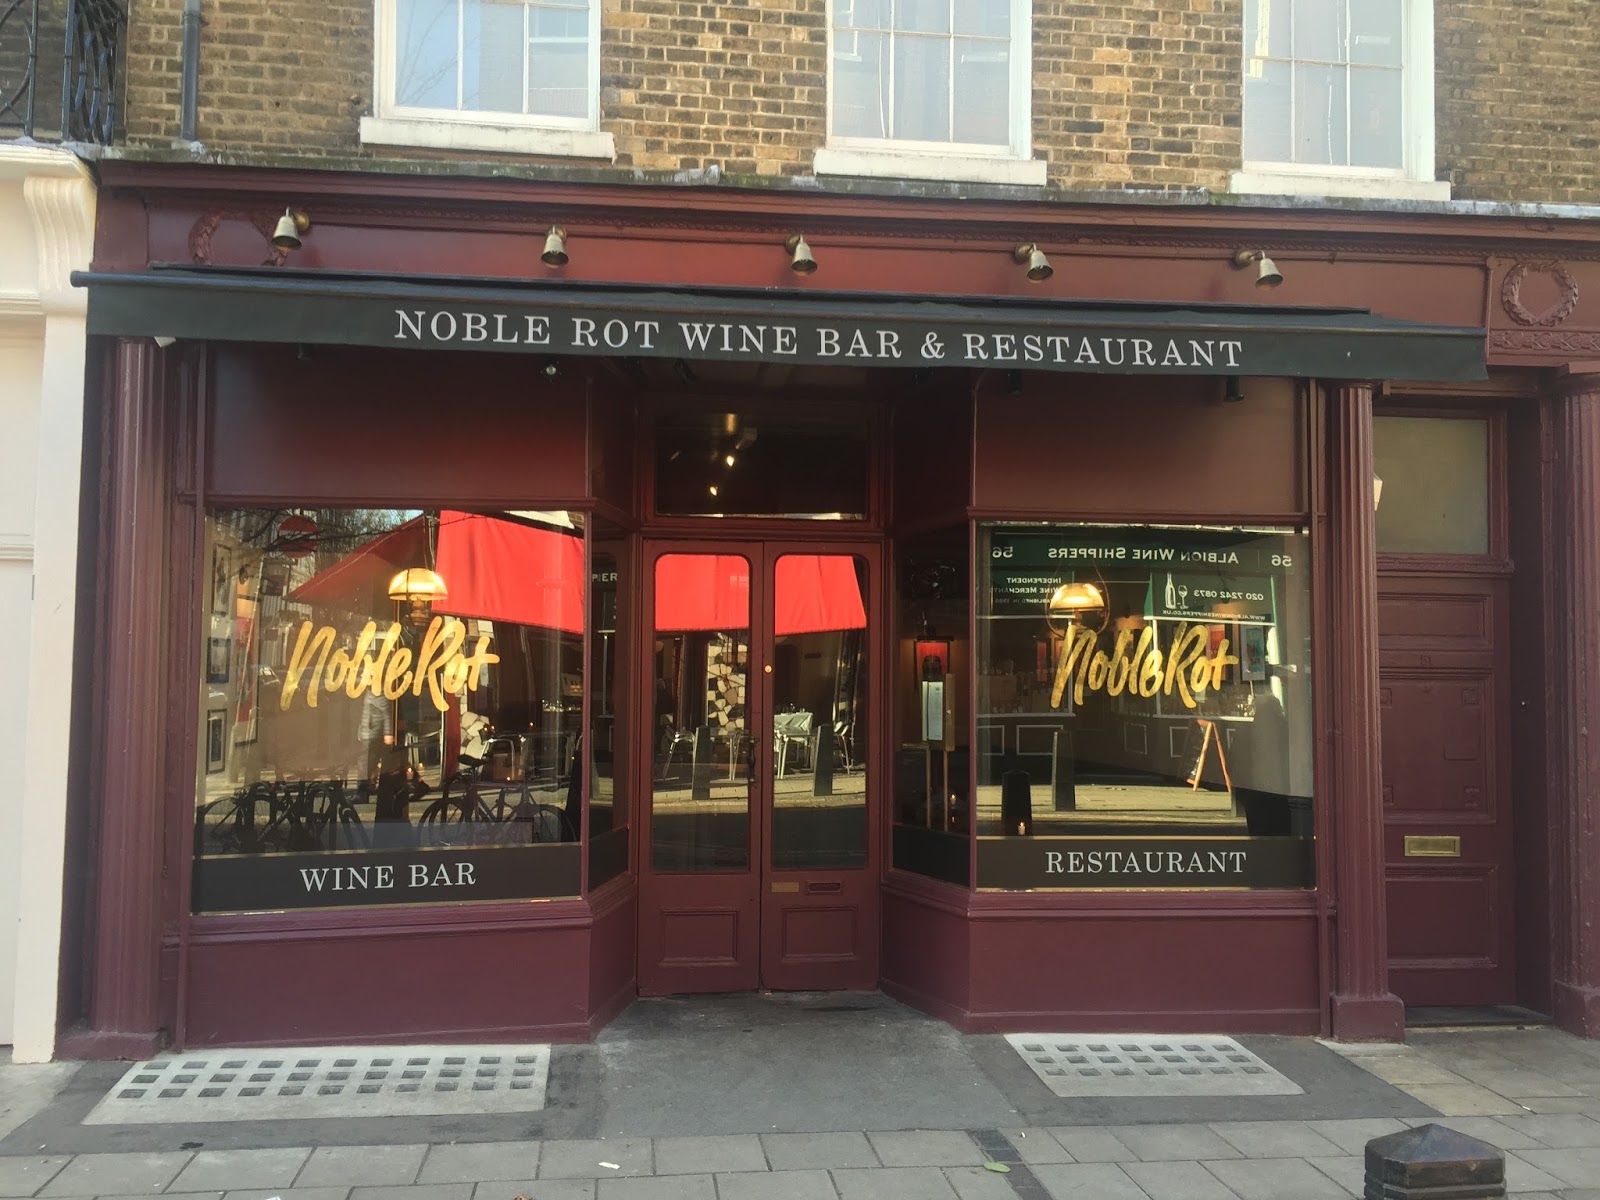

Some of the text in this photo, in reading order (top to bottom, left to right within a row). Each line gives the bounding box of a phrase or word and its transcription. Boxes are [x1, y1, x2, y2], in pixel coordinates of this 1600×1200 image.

[394, 309, 1243, 368] NOBLE ROT WINE BAR & RESTAURANT
[299, 862, 477, 892] WINE BAR
[1045, 851, 1247, 874] RESTAURANT
